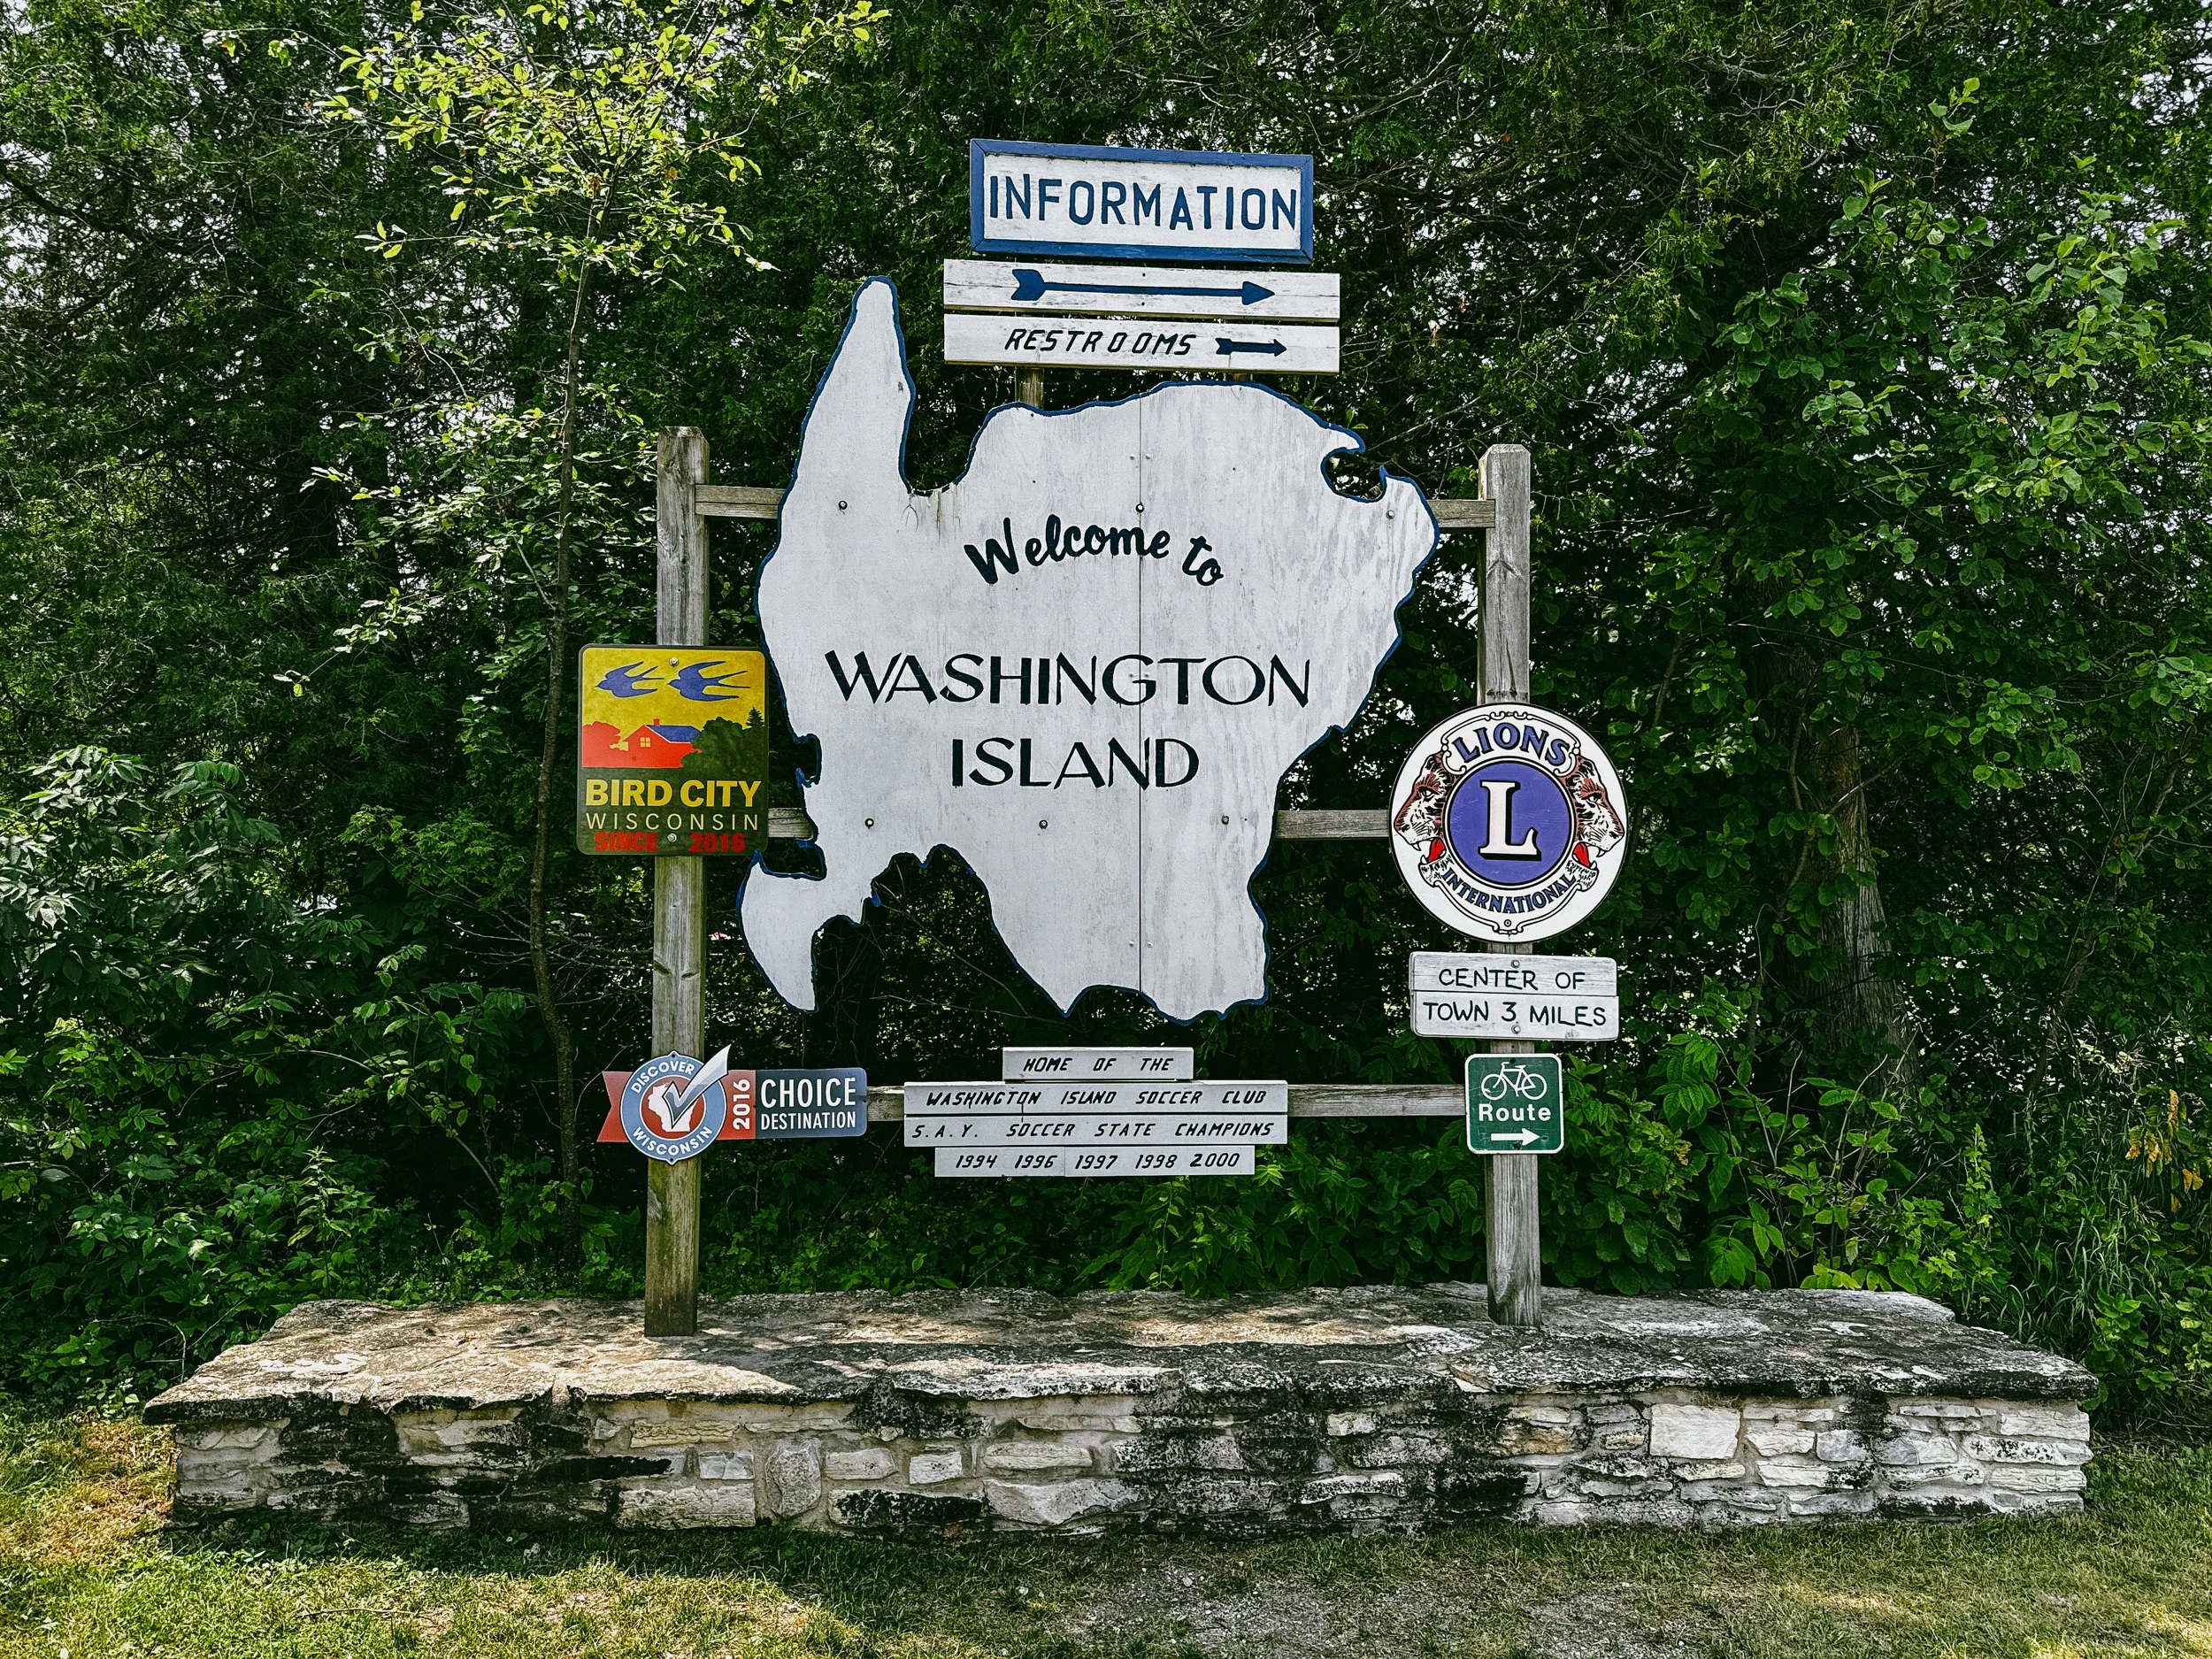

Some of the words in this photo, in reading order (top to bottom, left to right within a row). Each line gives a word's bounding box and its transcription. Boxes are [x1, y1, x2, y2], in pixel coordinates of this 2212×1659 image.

[990, 173, 1297, 231] INFORMATION
[1004, 328, 1197, 355] RESTROOMS
[964, 514, 1171, 585] Welcome
[1180, 535, 1225, 587] to
[825, 649, 1310, 708] WASHINGTON
[1451, 722, 1571, 765] LIONS
[951, 737, 1200, 790] ISLAND
[585, 779, 672, 806] BIRD
[680, 780, 762, 807] CITY
[586, 812, 758, 831] WISCONSIN
[1478, 780, 1542, 861] L
[594, 831, 660, 852] SINCE
[689, 833, 746, 853] 2016
[1441, 867, 1577, 914] INTERNATIONAL
[1439, 967, 1538, 991] CENTER
[1555, 972, 1586, 989] OF
[1423, 1000, 1489, 1022] TOWN
[1501, 1002, 1517, 1022] 3
[1530, 1005, 1607, 1026] MILES
[631, 1060, 695, 1094] DISCOVER
[1023, 1057, 1073, 1072] HOME
[1093, 1057, 1117, 1071] OF
[1140, 1057, 1174, 1071] THE
[733, 1079, 751, 1130] 2016
[760, 1077, 856, 1109] CHOICE
[926, 1091, 1041, 1105] WASHINGTON
[1061, 1091, 1117, 1104] ISLAND
[1135, 1091, 1203, 1104] SOCCER
[1221, 1090, 1267, 1104] CLUB
[760, 1111, 856, 1131] DESTINATION
[1479, 1103, 1551, 1122] Route
[631, 1125, 713, 1156] WISCONSIN
[1006, 1123, 1076, 1137] SOCCER
[1094, 1123, 1156, 1136] STATE
[1174, 1123, 1275, 1137] CHAMPIONS
[955, 1155, 998, 1169] 1994
[1014, 1155, 1058, 1169] 1996
[1074, 1155, 1118, 1170] 1997
[1135, 1154, 1178, 1169] 1998
[1189, 1153, 1240, 1167] 2000
